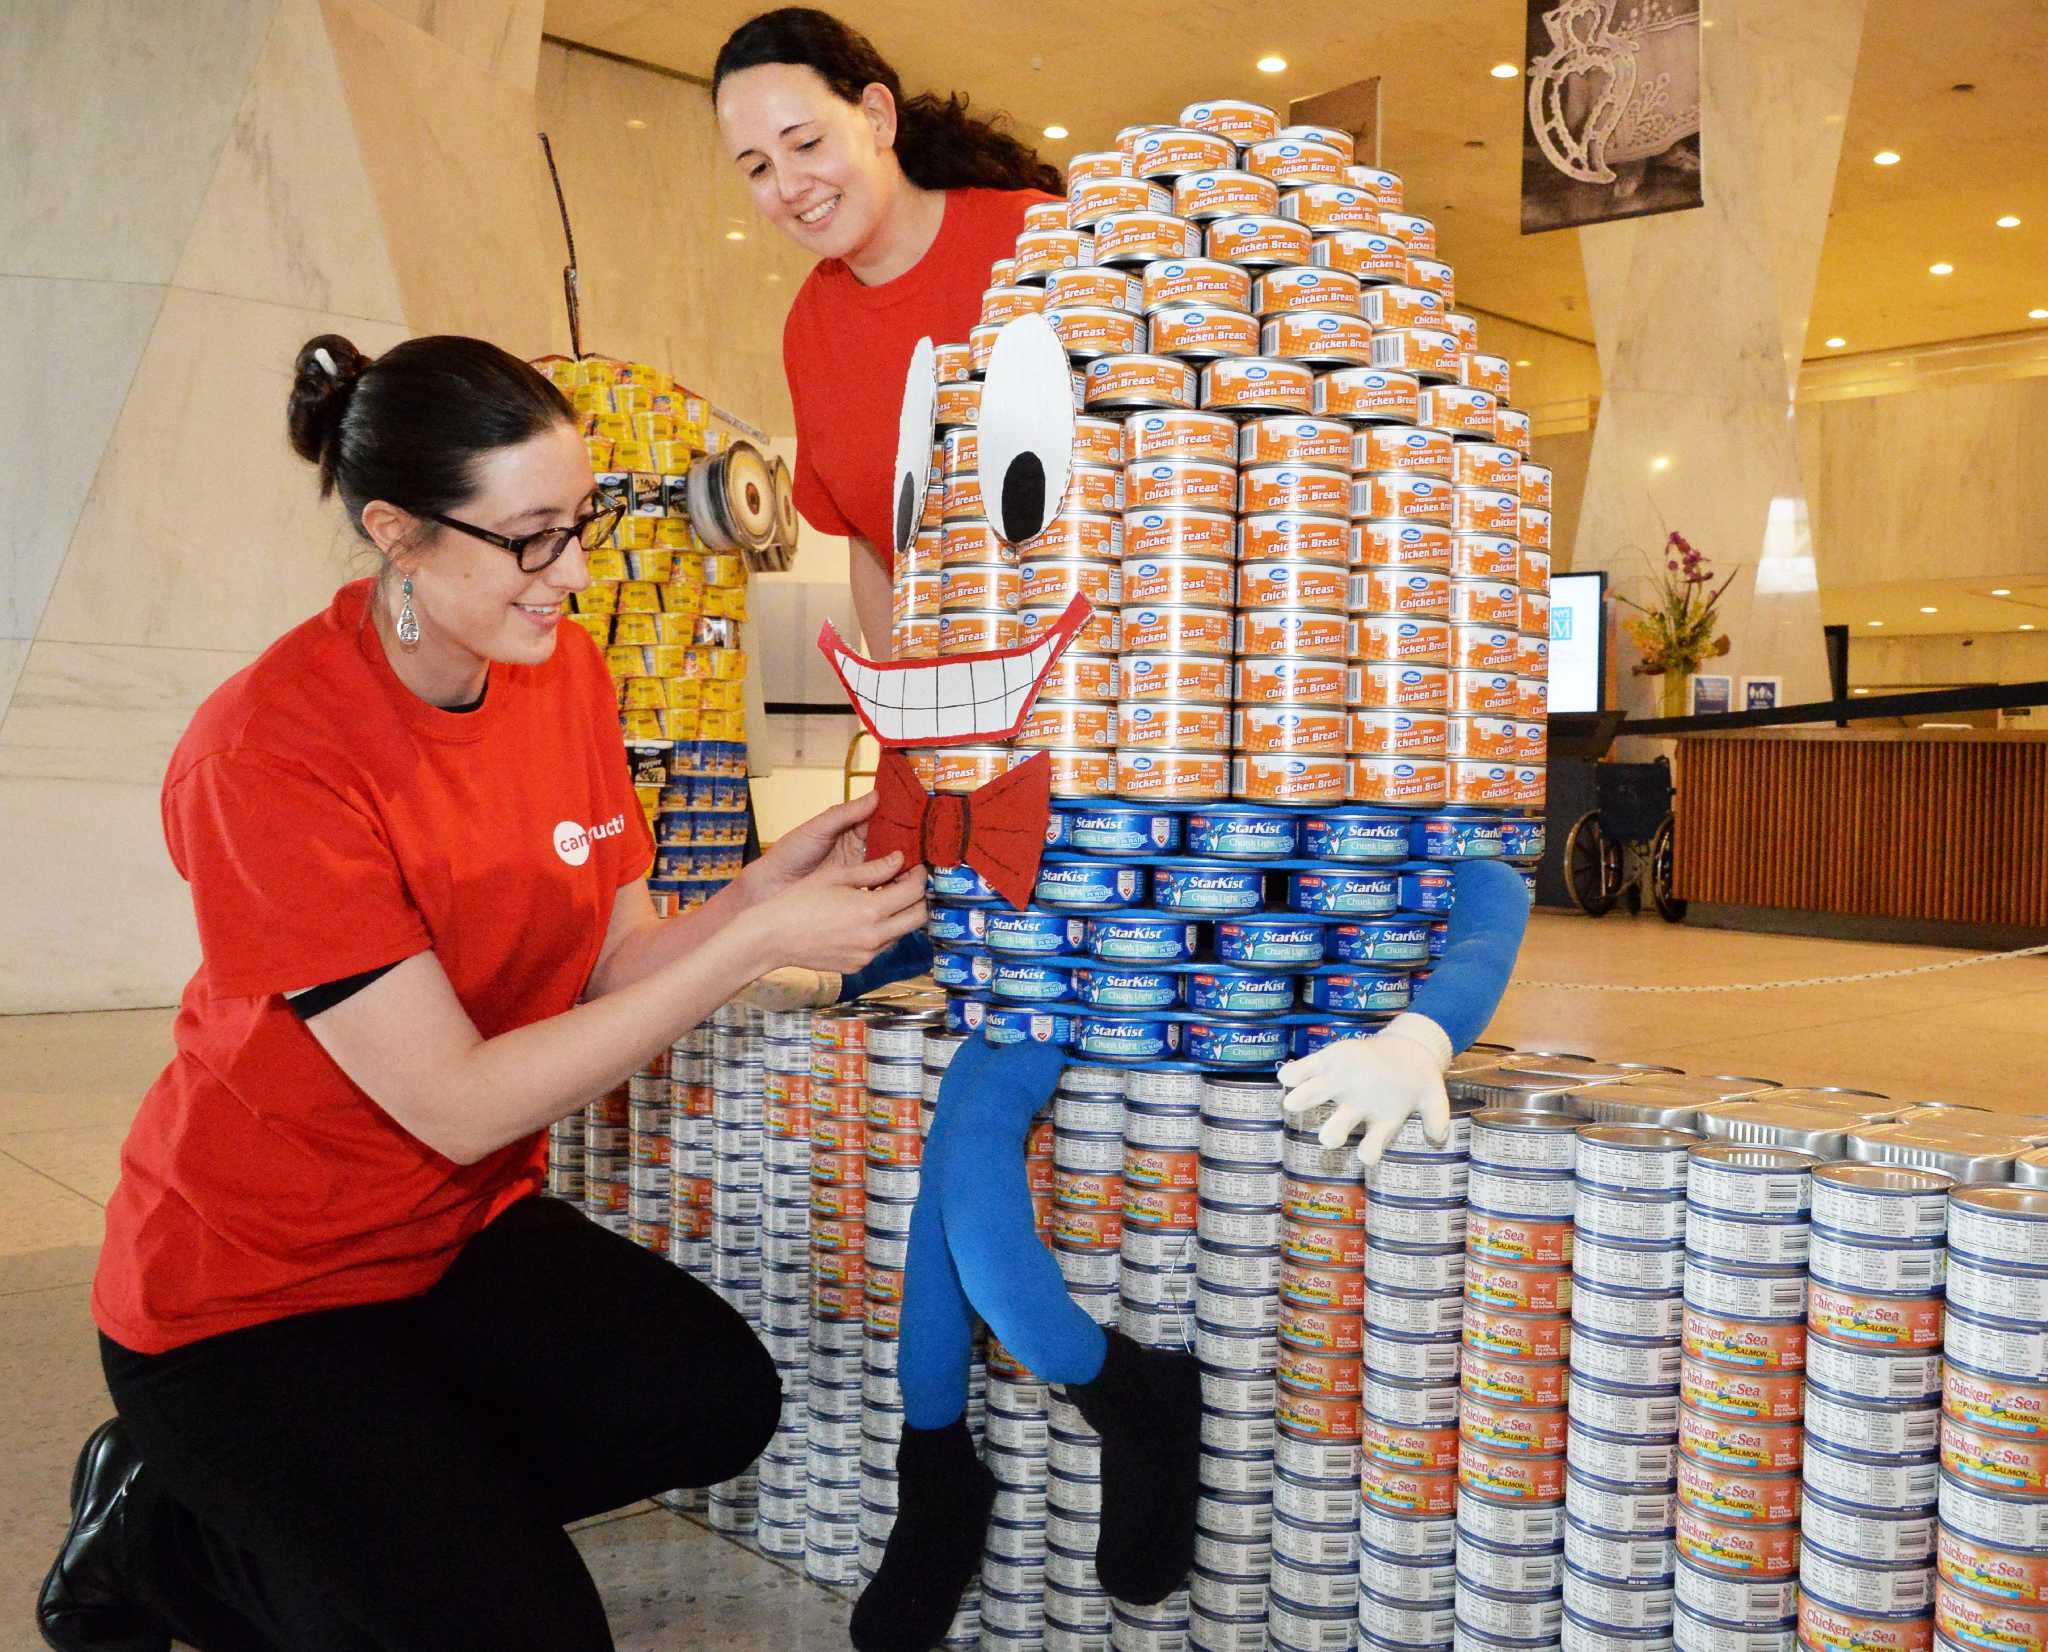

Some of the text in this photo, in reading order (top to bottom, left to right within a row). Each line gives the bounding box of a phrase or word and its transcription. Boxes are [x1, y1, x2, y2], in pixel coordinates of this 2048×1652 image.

[1221, 120, 1252, 130] Breast
[1138, 151, 1203, 174] Chicken Breast
[1271, 163, 1336, 177] Chicken Breast
[1088, 197, 1117, 210] Breast
[1189, 192, 1259, 210] Chicken Breast
[1328, 211, 1363, 222] Chicken
[1123, 231, 1156, 243] Breast
[1022, 249, 1047, 260] Breast
[1230, 240, 1300, 256] Chicken Breast
[1360, 260, 1393, 270] Chicken
[1064, 286, 1095, 298] Breast
[1157, 283, 1193, 299] Chicken
[1196, 282, 1229, 291] Breast
[1289, 295, 1328, 306] Chicken
[1414, 316, 1441, 325] Chicken
[1071, 327, 1106, 338] Breast
[1175, 332, 1248, 346] Chicken Breast
[1309, 340, 1348, 351] Chicken
[1089, 381, 1118, 398] Chicken
[1121, 376, 1155, 388] Breast
[1237, 386, 1306, 400] Chicken Breast
[1356, 397, 1395, 409] Chicken
[1464, 416, 1493, 425] Chicken
[1137, 433, 1212, 451] Chicken Breast
[1287, 446, 1327, 458] Chicken
[1400, 455, 1435, 466] Chicken
[1491, 474, 1518, 482] Chicken
[1144, 484, 1219, 501] Chicken Breast
[1268, 491, 1340, 507] Chicken Breast
[1403, 503, 1438, 514] Chicken
[1491, 519, 1517, 528] Chicken
[955, 540, 985, 551] Breast
[1136, 535, 1172, 550] Chicken
[1312, 538, 1340, 549] Breast
[958, 585, 988, 596] Breast
[1133, 586, 1167, 599] Chicken
[1304, 584, 1335, 596] Breast
[1400, 598, 1433, 609] Chicken
[959, 631, 990, 643] Breast
[1132, 632, 1167, 647] Chicken
[1314, 634, 1341, 645] Breast
[1483, 655, 1513, 665] Chicken
[1127, 681, 1161, 694] Chicken
[1309, 682, 1337, 692] Breast
[1395, 691, 1429, 704] Chicken
[1127, 729, 1161, 743] Chicken
[1312, 730, 1338, 742] Breast
[1381, 737, 1421, 750] Chicken
[946, 767, 976, 779] Breast
[1127, 773, 1200, 791] Chicken Breast
[1275, 776, 1341, 795] Chicken Breast
[1384, 784, 1423, 797] Chicken
[1075, 816, 1123, 830] StarKist
[1226, 822, 1281, 835] StarKist
[1348, 825, 1399, 838] StarKist
[1042, 869, 1090, 883] StarKist
[1188, 876, 1245, 890] StarKist
[1344, 881, 1391, 894] StarKist
[993, 918, 1041, 932] StarKist
[1108, 927, 1163, 940] StarKist
[1262, 930, 1313, 943] StarKist
[1382, 930, 1427, 942] StarKist
[999, 967, 1045, 980] StarKist
[1105, 975, 1160, 988] StarKist
[1237, 980, 1285, 992] StarKist
[1092, 1025, 1144, 1038] StarKist
[1231, 1032, 1280, 1044] StarKist
[1146, 1158, 1163, 1169] Sea
[1083, 1180, 1099, 1191] Sea
[1325, 1192, 1344, 1203] Sea
[1314, 1234, 1333, 1245] Sea
[1504, 1228, 1526, 1241] Sea
[1312, 1277, 1331, 1288] Sea
[1499, 1276, 1520, 1289] Sea
[1813, 1293, 1900, 1321] Chicken Sea
[1307, 1318, 1325, 1330] Sea
[1501, 1324, 1522, 1337] Sea
[1865, 1324, 1898, 1333] SALMON
[1688, 1318, 1768, 1346] Chicken Sea
[1495, 1337, 1521, 1347] SALMON
[1735, 1348, 1768, 1358] SALMON
[1503, 1371, 1524, 1384] Sea
[1682, 1367, 1760, 1396] Chicken Sea
[1949, 1377, 2040, 1410] Chicken Sea
[1303, 1404, 1321, 1416] Sea
[1728, 1399, 1759, 1408] SALMON
[1463, 1405, 1532, 1431] Chicken Sea
[2003, 1411, 2039, 1423] SALMON
[1501, 1431, 1530, 1441] SALMON
[1683, 1416, 1760, 1447] Chicken Sea
[1405, 1437, 1425, 1449] Sea
[1944, 1428, 2029, 1465] Chicken Sea
[1728, 1448, 1760, 1458] SALMON
[1504, 1466, 1526, 1479] Sea
[1991, 1464, 2028, 1477] SALMON
[1397, 1481, 1418, 1492] Sea
[1497, 1479, 1525, 1489] SALMON
[1680, 1465, 1755, 1498] Chicken Sea
[1723, 1500, 1754, 1510] SALMON
[1680, 1517, 1753, 1549] Chicken Sea
[1721, 1551, 1753, 1561] SALMON
[1940, 1537, 2024, 1577] Chicken Sea
[1987, 1576, 2023, 1589] SALMON
[1942, 1594, 2032, 1633] Chicken Sea
[1807, 1609, 1896, 1642] Chicken Sea
[1994, 1631, 2031, 1645] SALMON
[1862, 1644, 1896, 1652] SALMON
